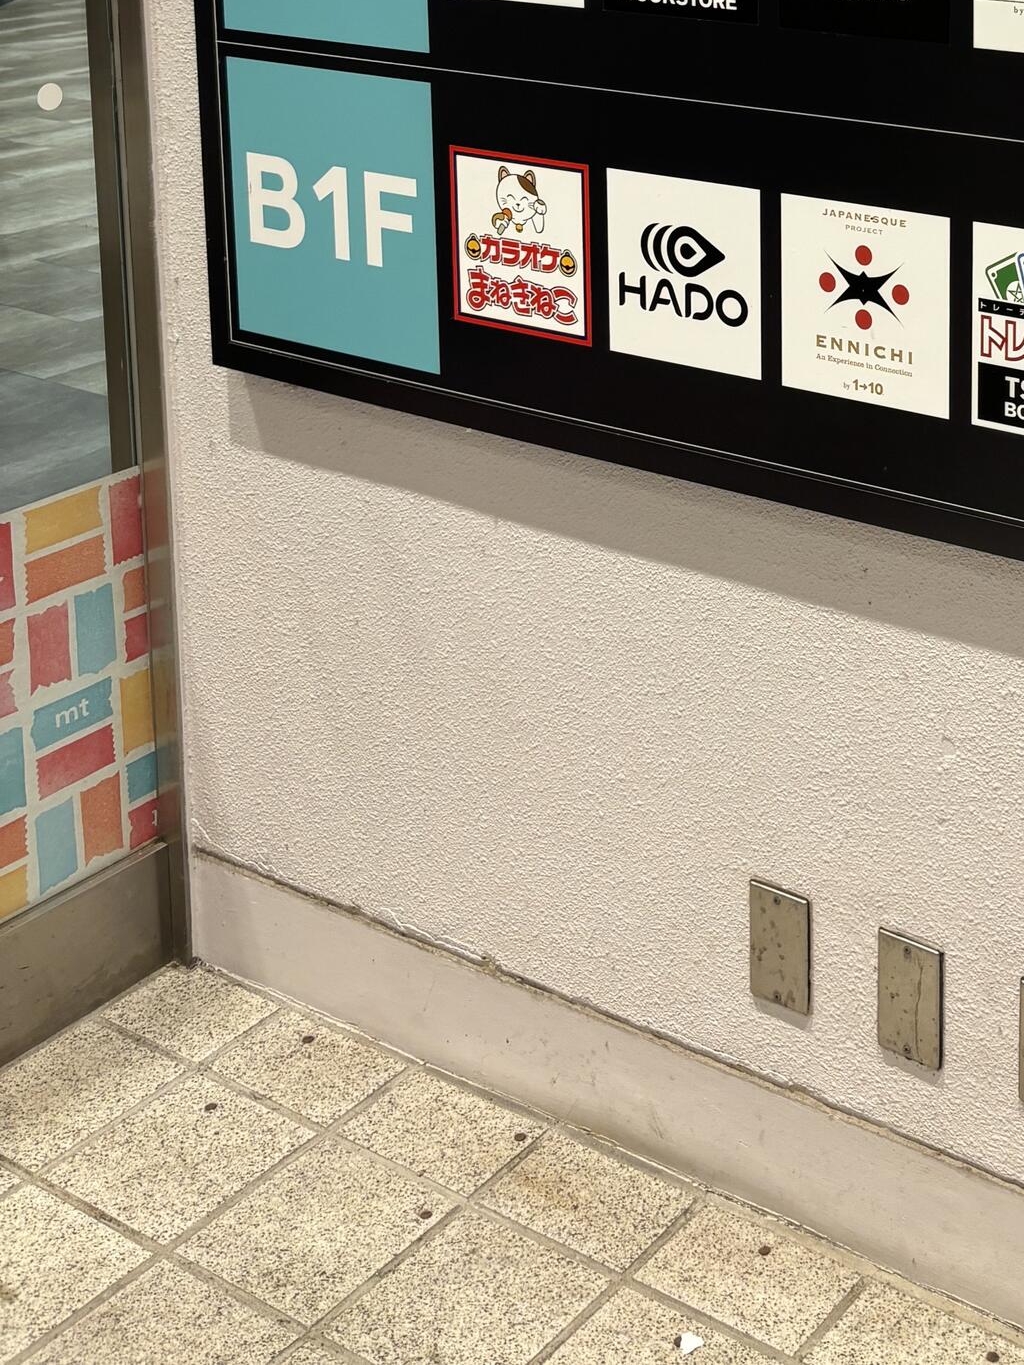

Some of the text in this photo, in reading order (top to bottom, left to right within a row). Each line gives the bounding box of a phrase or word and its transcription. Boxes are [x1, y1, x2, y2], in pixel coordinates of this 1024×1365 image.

[1013, 6, 1024, 15] by
[245, 151, 419, 268] B1F
[822, 208, 907, 228] JAPANESQUE
[845, 224, 883, 235] PROJECT
[480, 234, 560, 273] カラオケ
[466, 266, 578, 325] まねきねこ
[619, 271, 748, 327] HADO
[816, 334, 913, 364] ENNICHI
[816, 353, 826, 361] An
[827, 355, 865, 368] Experience
[875, 364, 913, 377] Connection
[55, 698, 90, 728] mt
